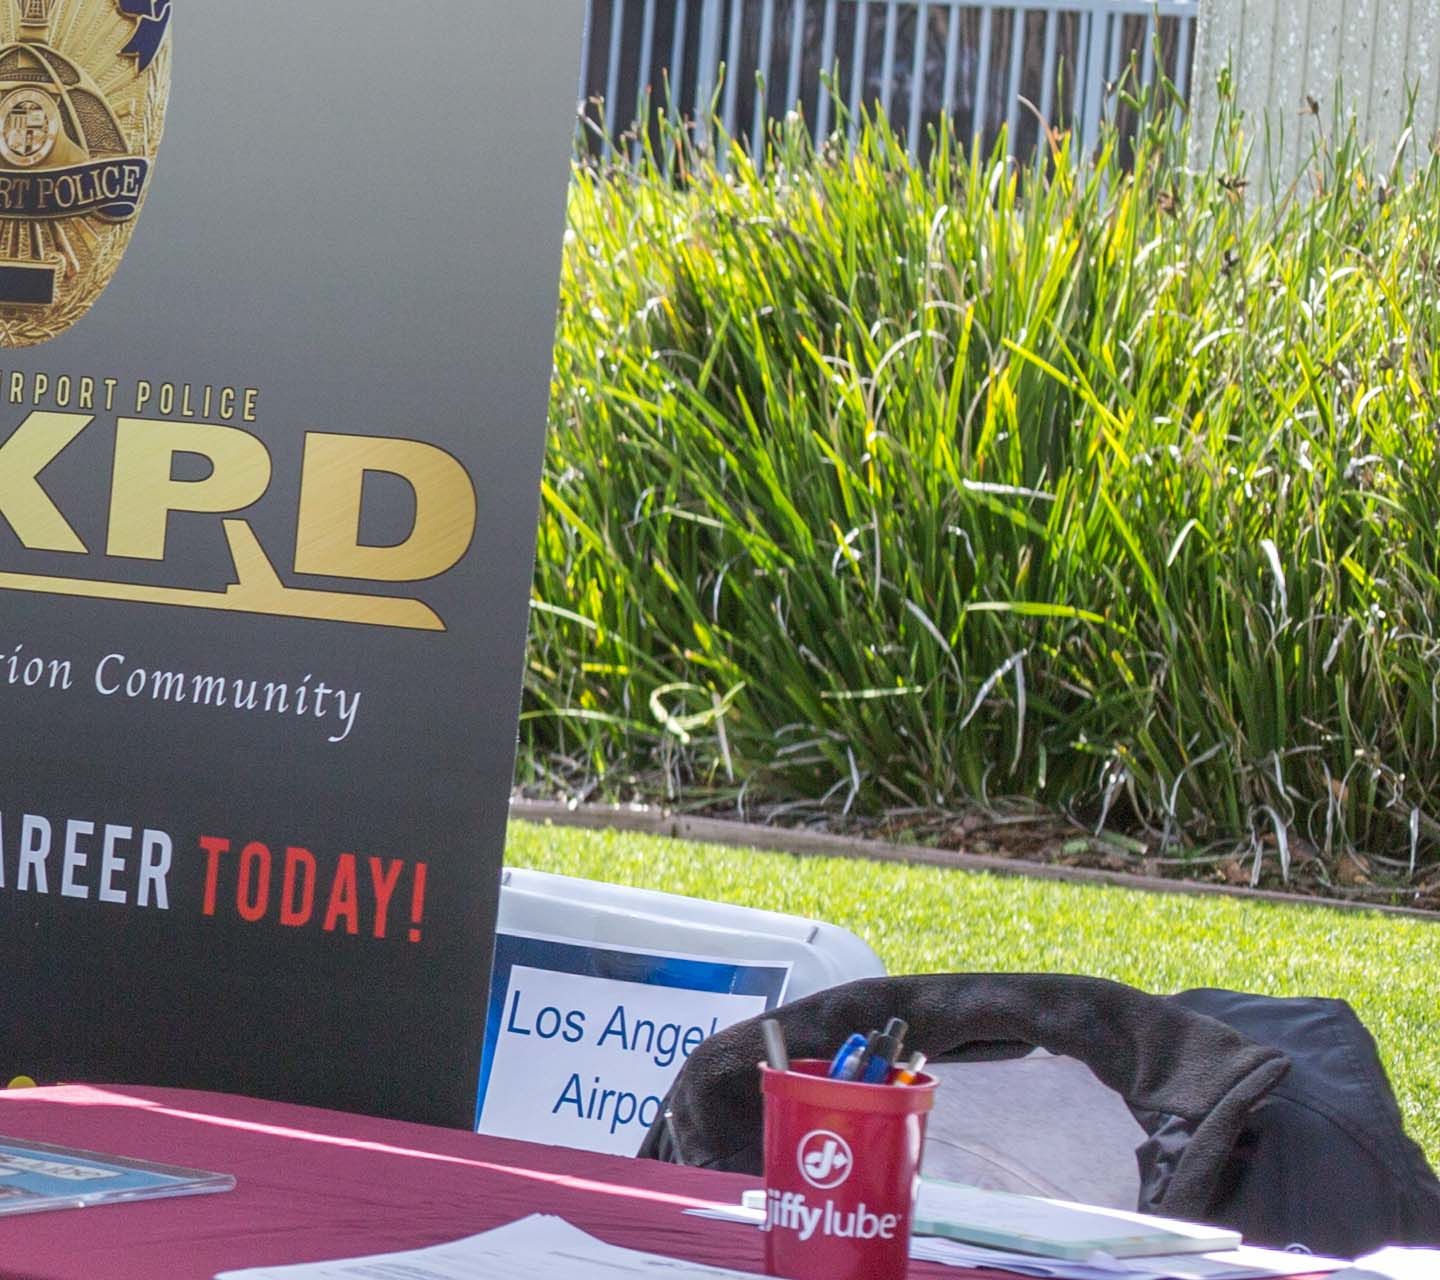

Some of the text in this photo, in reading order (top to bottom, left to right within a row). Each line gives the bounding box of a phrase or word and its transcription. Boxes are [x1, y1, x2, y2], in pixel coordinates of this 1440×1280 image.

[38, 166, 141, 208] POLICE
[135, 379, 260, 422] POLICE
[93, 653, 362, 741] Community
[198, 835, 429, 943] TODAY!
[506, 990, 585, 1043] Los
[758, 1188, 897, 1241] jiffy lube
